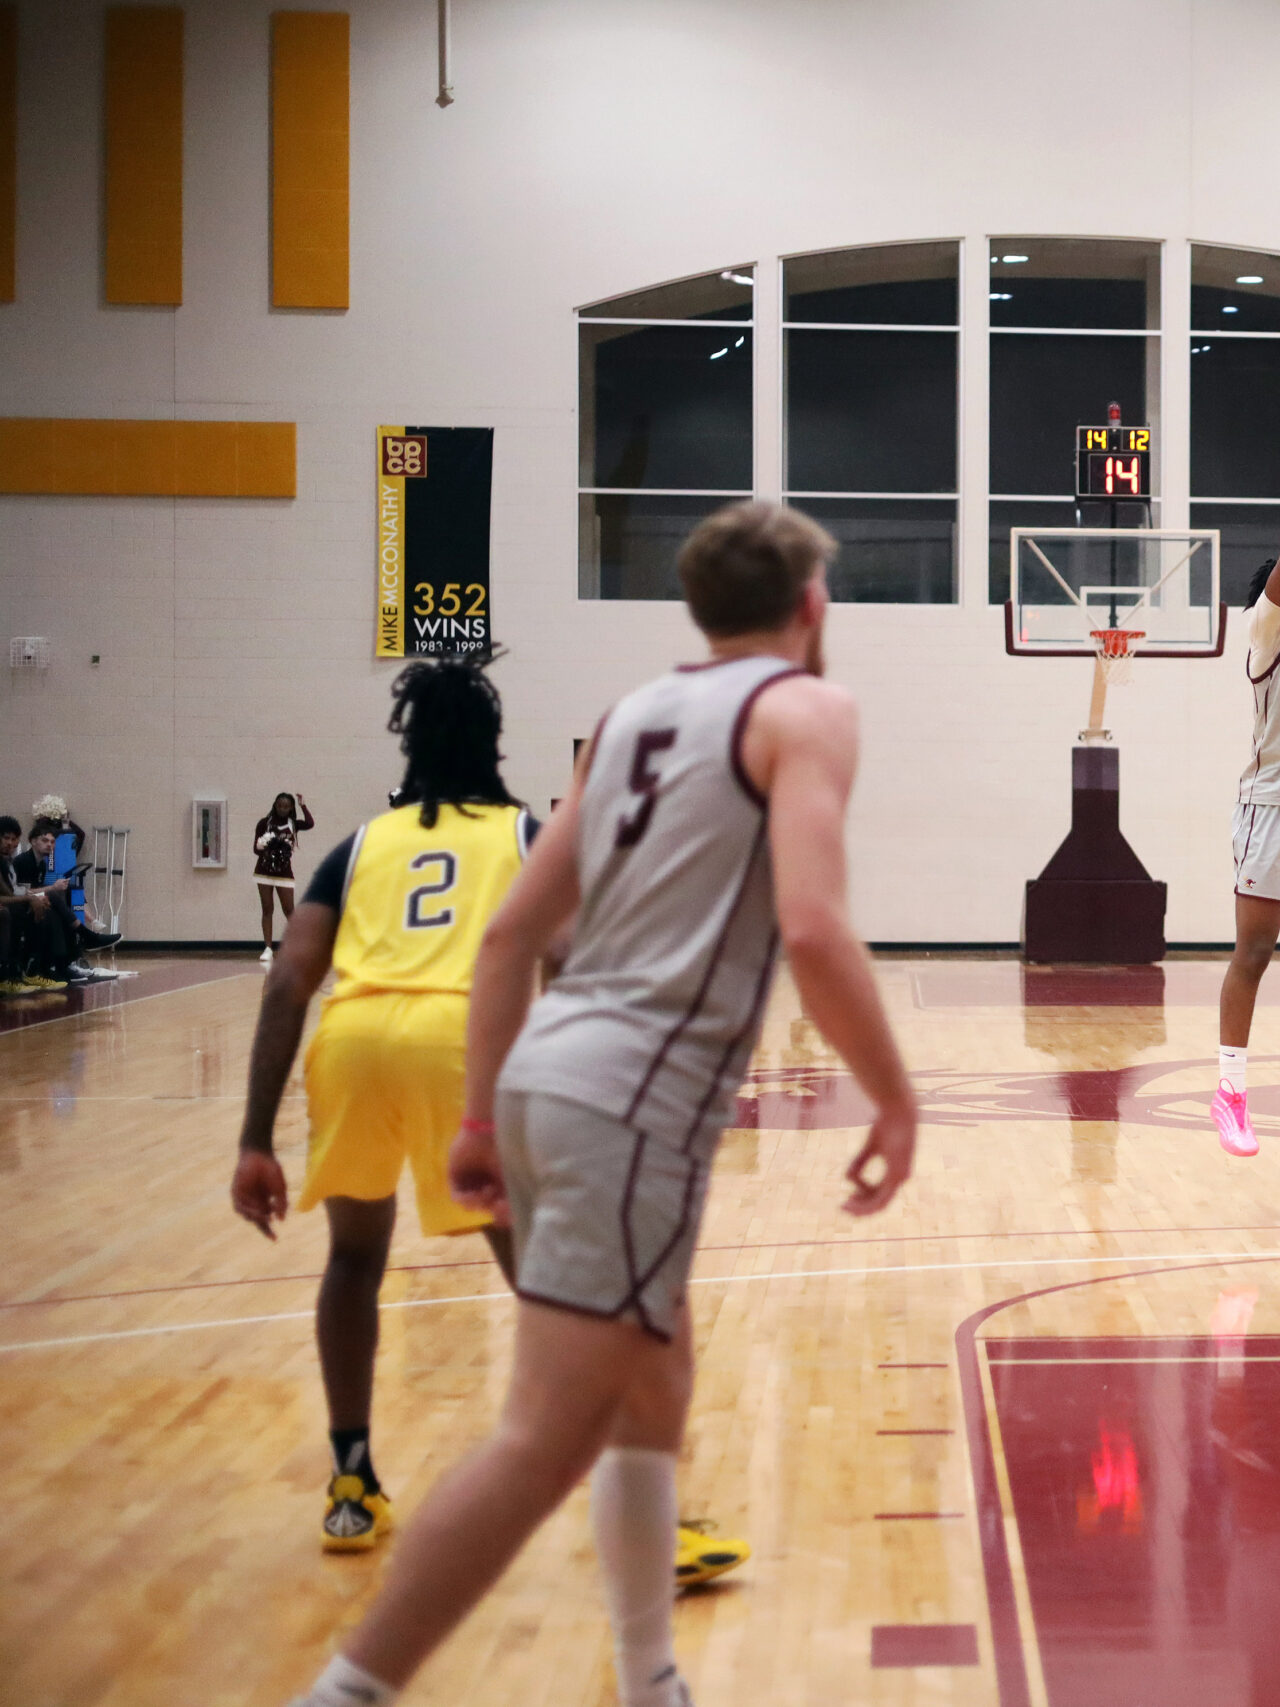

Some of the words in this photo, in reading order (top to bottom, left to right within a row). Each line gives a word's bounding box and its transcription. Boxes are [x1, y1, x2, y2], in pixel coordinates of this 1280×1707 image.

[1105, 456, 1139, 494] 14
[382, 485, 398, 606] MCCONATHY
[413, 582, 486, 616] 352
[383, 606, 398, 651] MIKE
[413, 617, 486, 639] WINS
[614, 728, 678, 848] 5
[405, 850, 456, 929] 2
